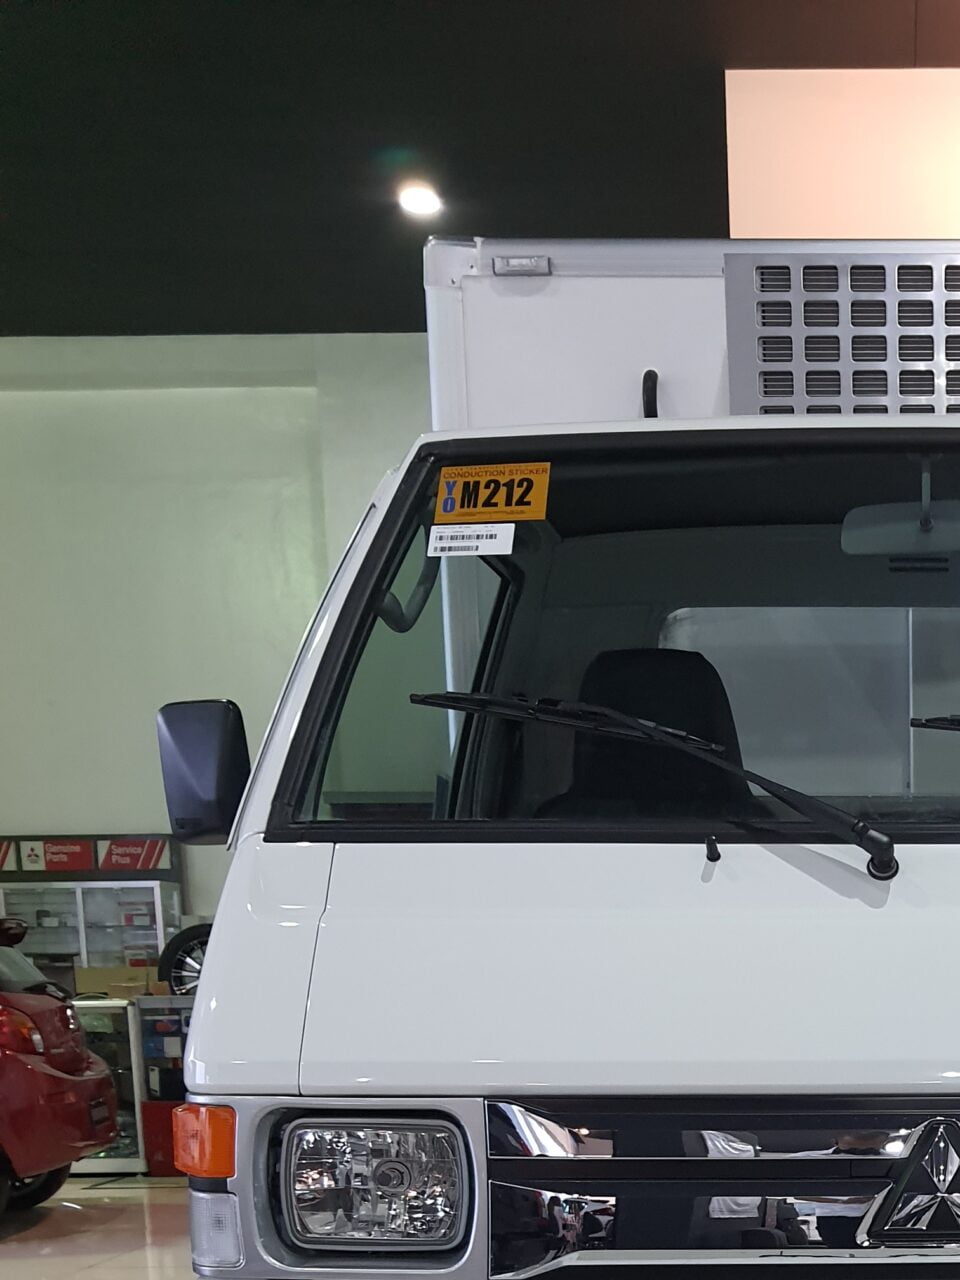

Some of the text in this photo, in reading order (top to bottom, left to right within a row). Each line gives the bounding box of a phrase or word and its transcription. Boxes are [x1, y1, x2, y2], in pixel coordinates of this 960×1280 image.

[443, 467, 548, 479] CONDUCTION STICKER
[460, 477, 534, 509] M212
[111, 845, 142, 854] Service
[111, 855, 130, 864] Plus
